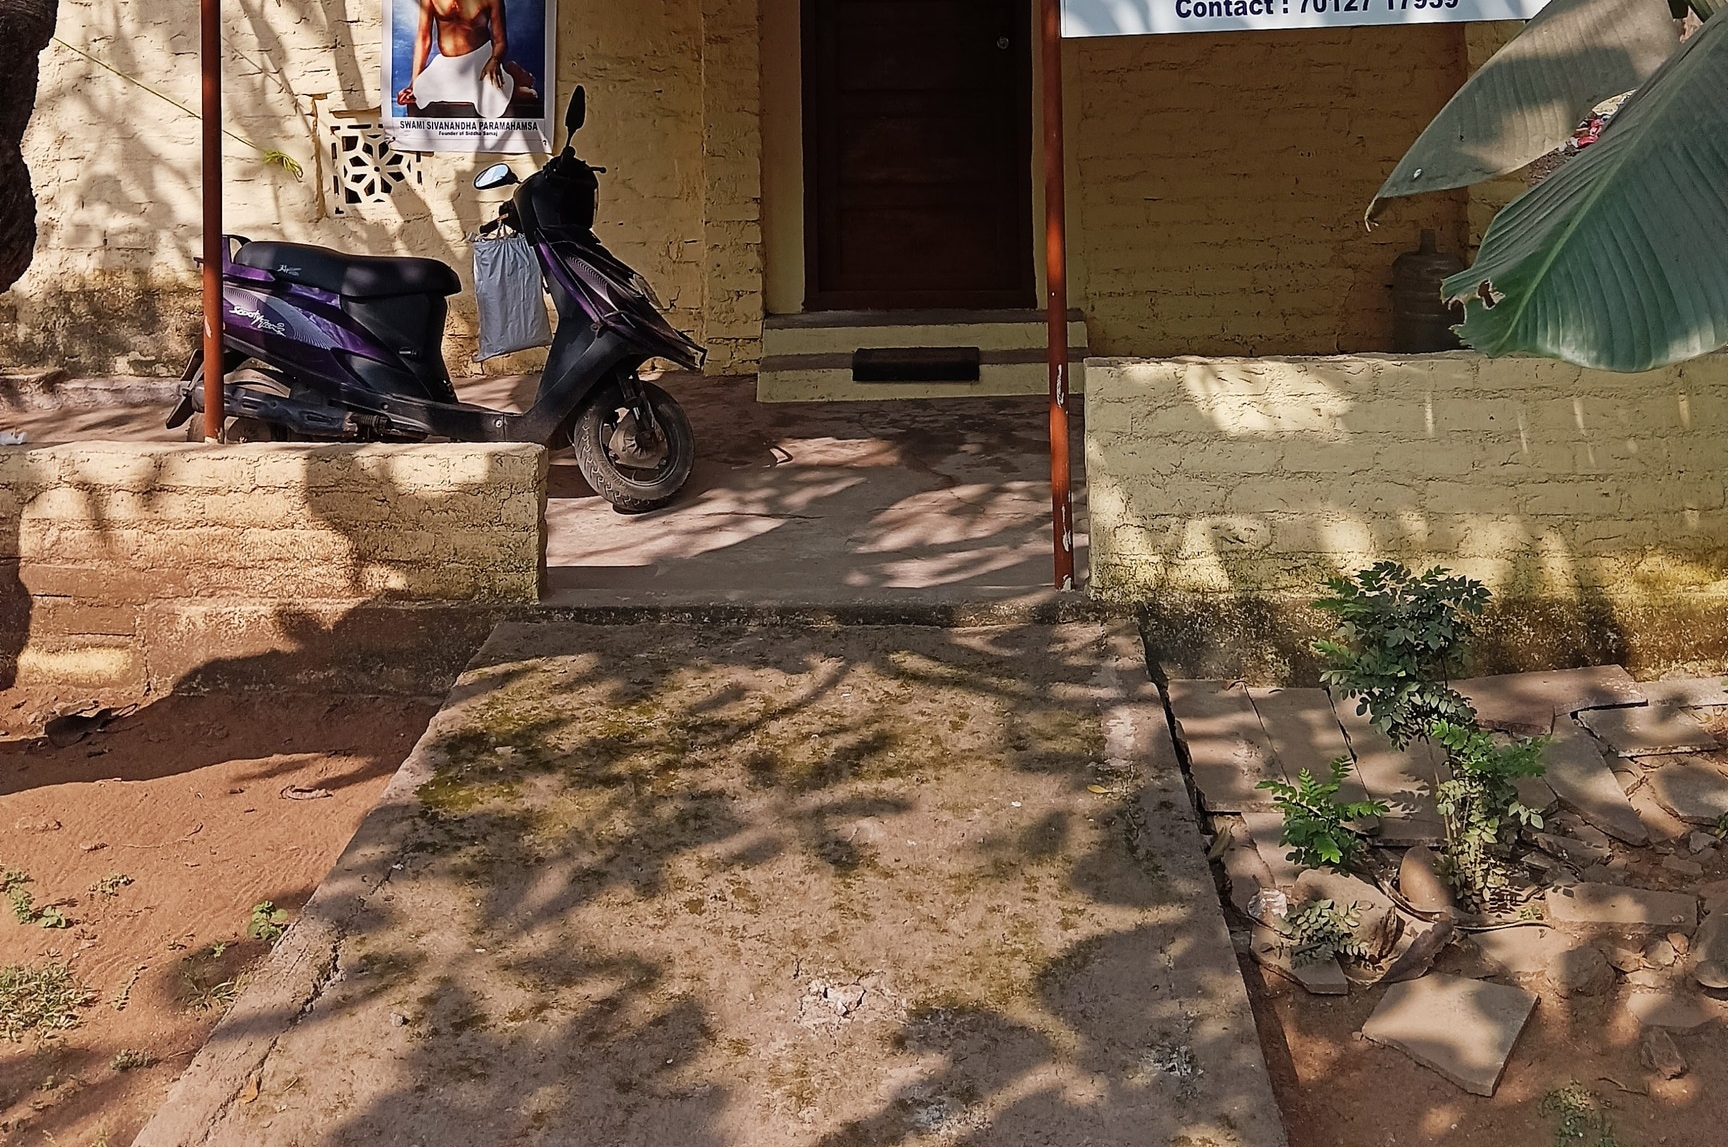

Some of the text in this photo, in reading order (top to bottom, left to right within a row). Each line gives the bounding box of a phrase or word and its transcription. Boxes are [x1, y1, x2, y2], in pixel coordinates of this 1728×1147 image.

[400, 120, 538, 131] SWAMI SIVANANDHA PARAMAHAMSA
[229, 306, 264, 325] Scooty
